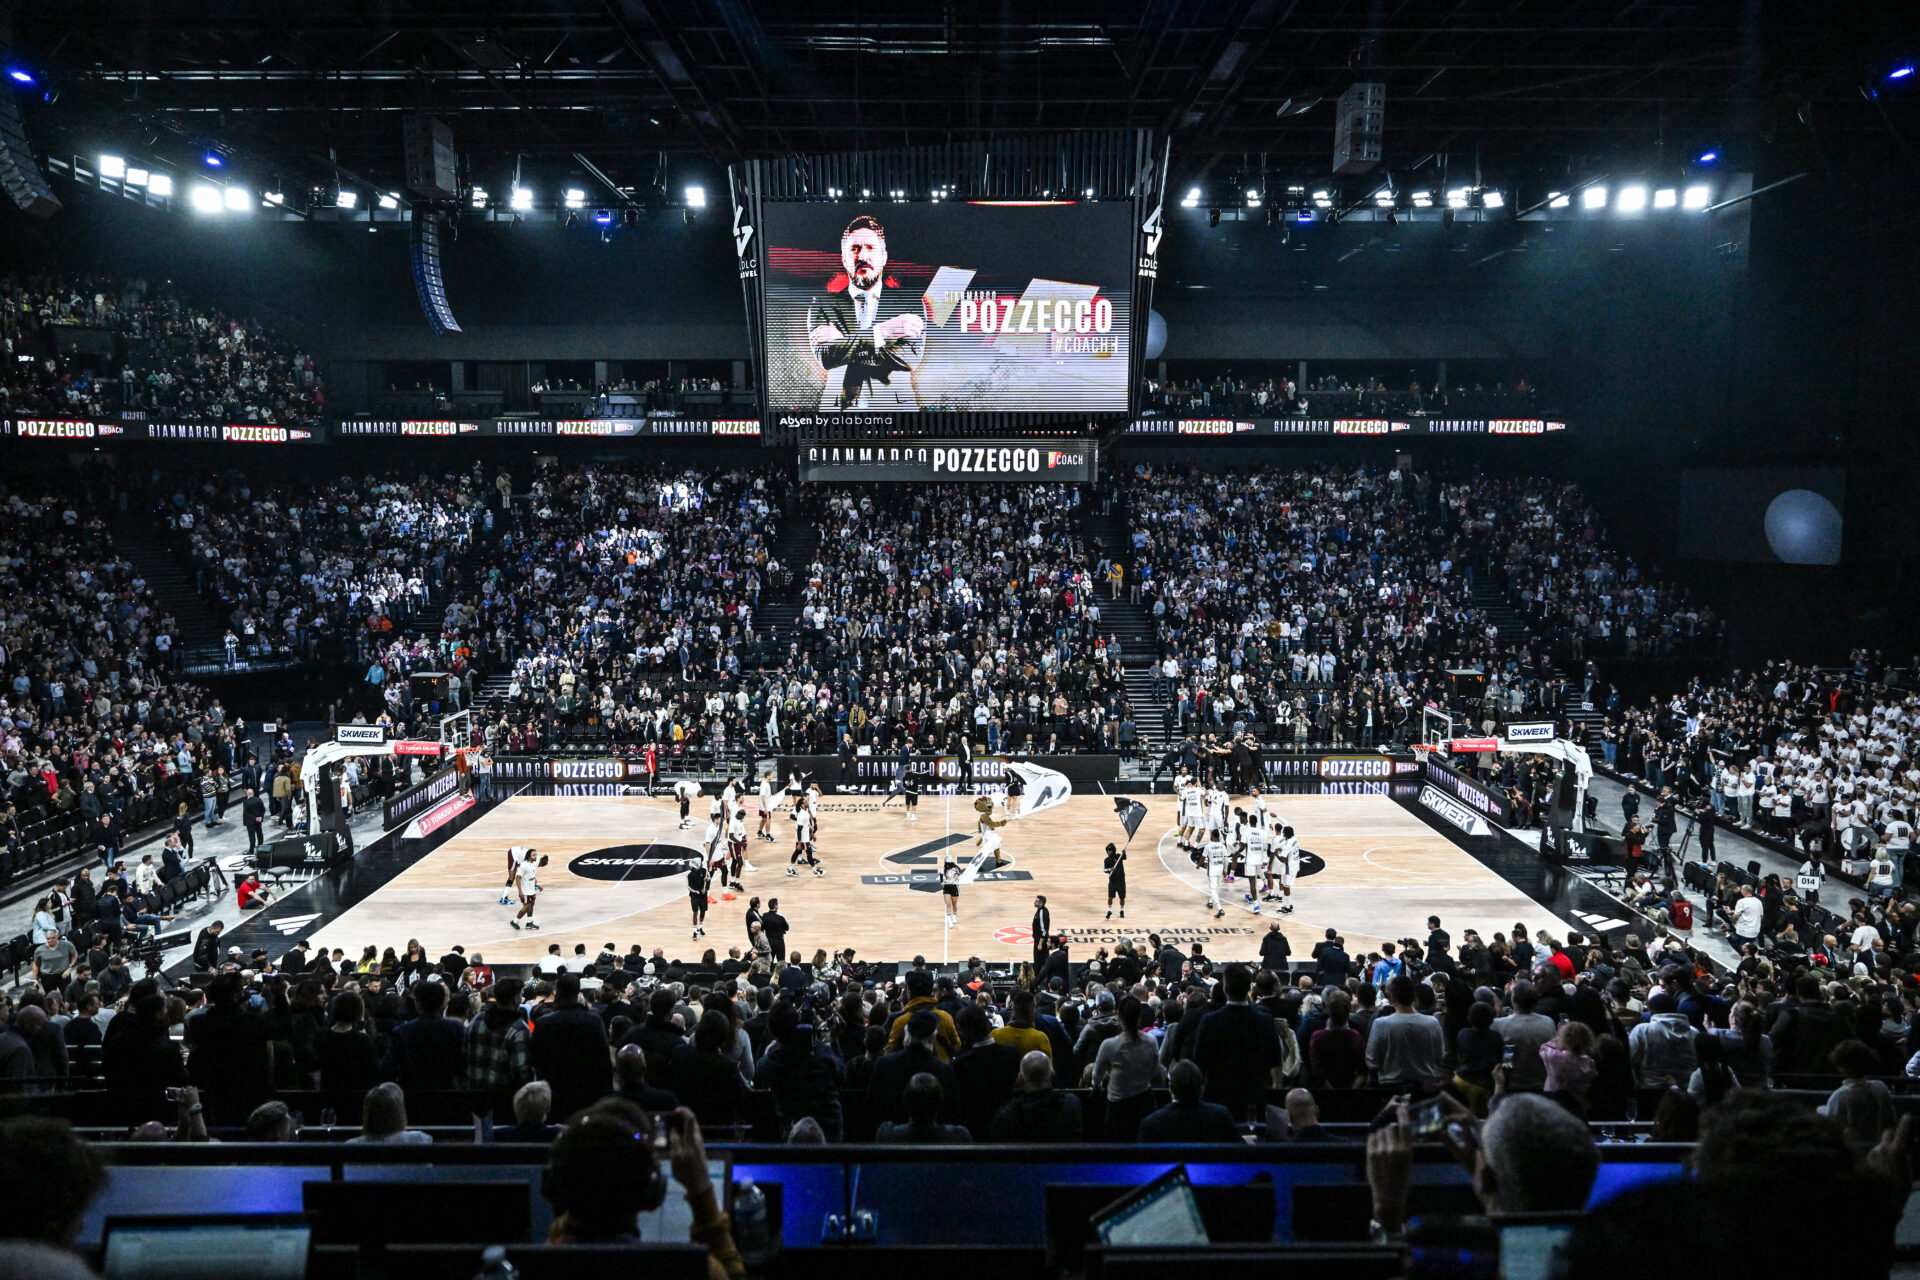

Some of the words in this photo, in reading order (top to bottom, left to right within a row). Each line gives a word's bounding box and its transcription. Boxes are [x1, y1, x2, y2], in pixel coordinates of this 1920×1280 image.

[960, 299, 1113, 333] POZZECCO
[341, 421, 397, 434] GIANMARCO
[401, 421, 457, 435] POZZECCO
[497, 421, 553, 433] GIANMARCO
[556, 421, 612, 435] POZZECCO
[652, 421, 708, 433] GIANMARCO
[711, 421, 760, 434] POZZECC
[815, 415, 829, 427] by
[831, 415, 893, 425] alabama
[1126, 420, 1174, 433] ANMARCO
[1178, 420, 1234, 434] POZZECCO
[1274, 420, 1329, 432] GIANMARCO
[1333, 420, 1389, 433] POZZECCO
[1429, 420, 1485, 432] GIANMARCO
[1488, 420, 1544, 433] POZZECCO
[17, 420, 95, 437] POZZECCO
[148, 424, 217, 439] GIANMARCO
[222, 426, 287, 442] POZZECCO
[933, 448, 1040, 472] POZZECCO
[340, 729, 380, 738] SKWEEK
[1510, 727, 1551, 737] SKWEEK
[553, 762, 623, 778] POZZECCO
[857, 762, 935, 776] GIANMRCO
[1264, 760, 1317, 776] NMARCO
[1320, 761, 1391, 776] POZZECCO
[427, 771, 456, 802] POZZECCO
[1457, 780, 1489, 813] POZZECCO
[1422, 790, 1474, 830] SKWEEK
[874, 875, 927, 883] LDLC
[1683, 907, 1690, 917] 9
[1160, 927, 1255, 935] AIRLINES
